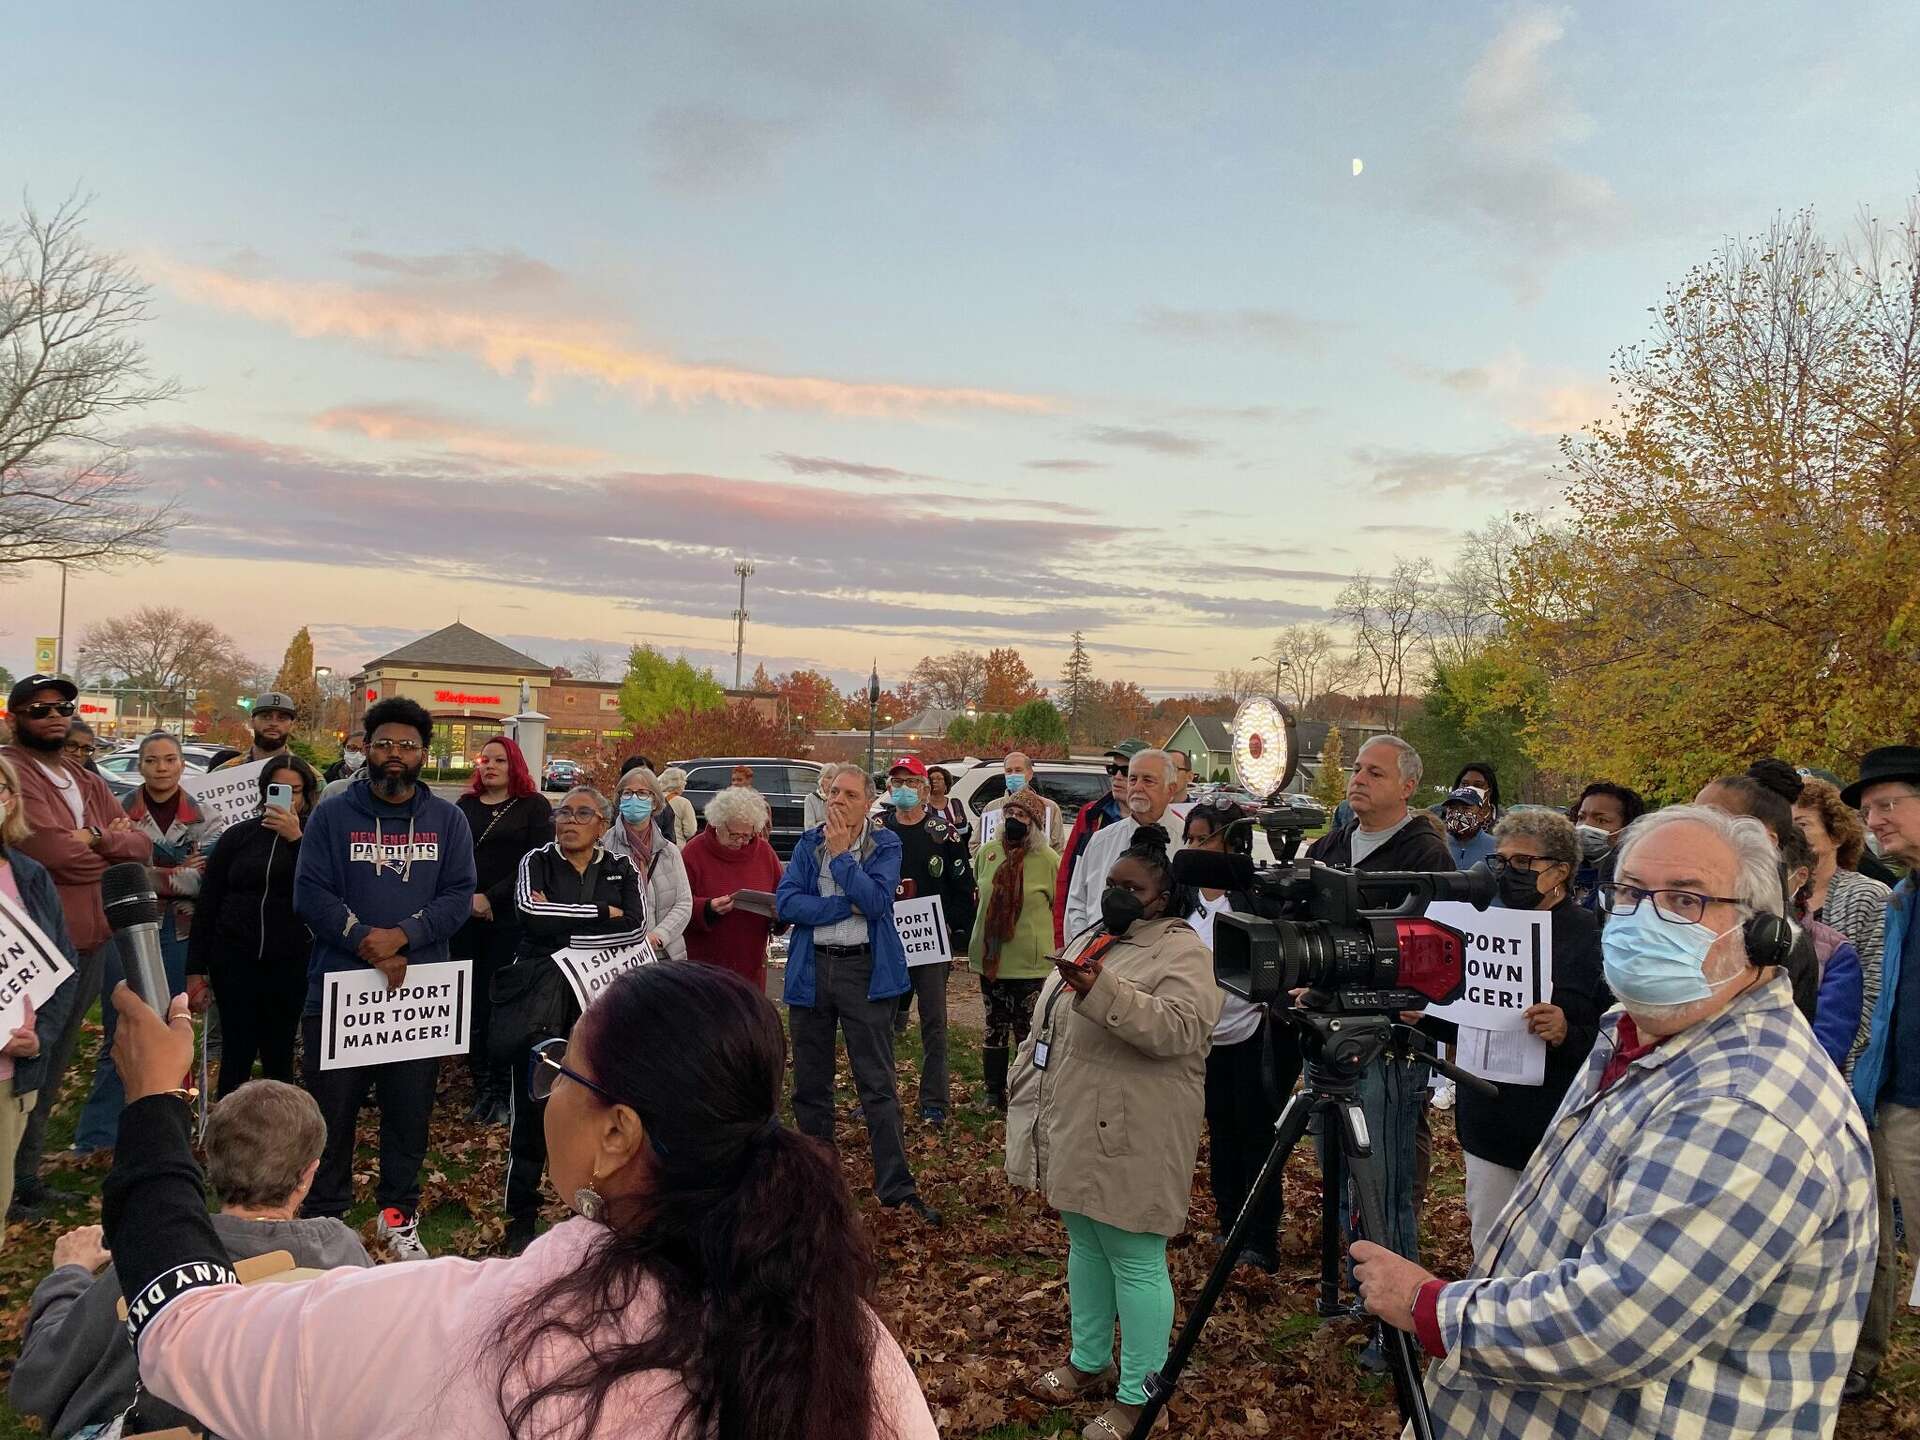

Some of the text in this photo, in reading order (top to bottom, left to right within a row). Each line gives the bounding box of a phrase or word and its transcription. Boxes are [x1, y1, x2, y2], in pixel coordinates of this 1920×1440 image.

[271, 695, 280, 705] B
[196, 777, 260, 802] SUPPOR
[383, 832, 438, 845] ENGAND
[897, 926, 933, 940] OWN
[581, 961, 589, 974] I
[346, 984, 451, 1007] I SUPPORT
[1462, 986, 1523, 1010] GER!
[343, 1004, 451, 1028] OUR TOWN
[343, 1024, 450, 1049] MANAGER!
